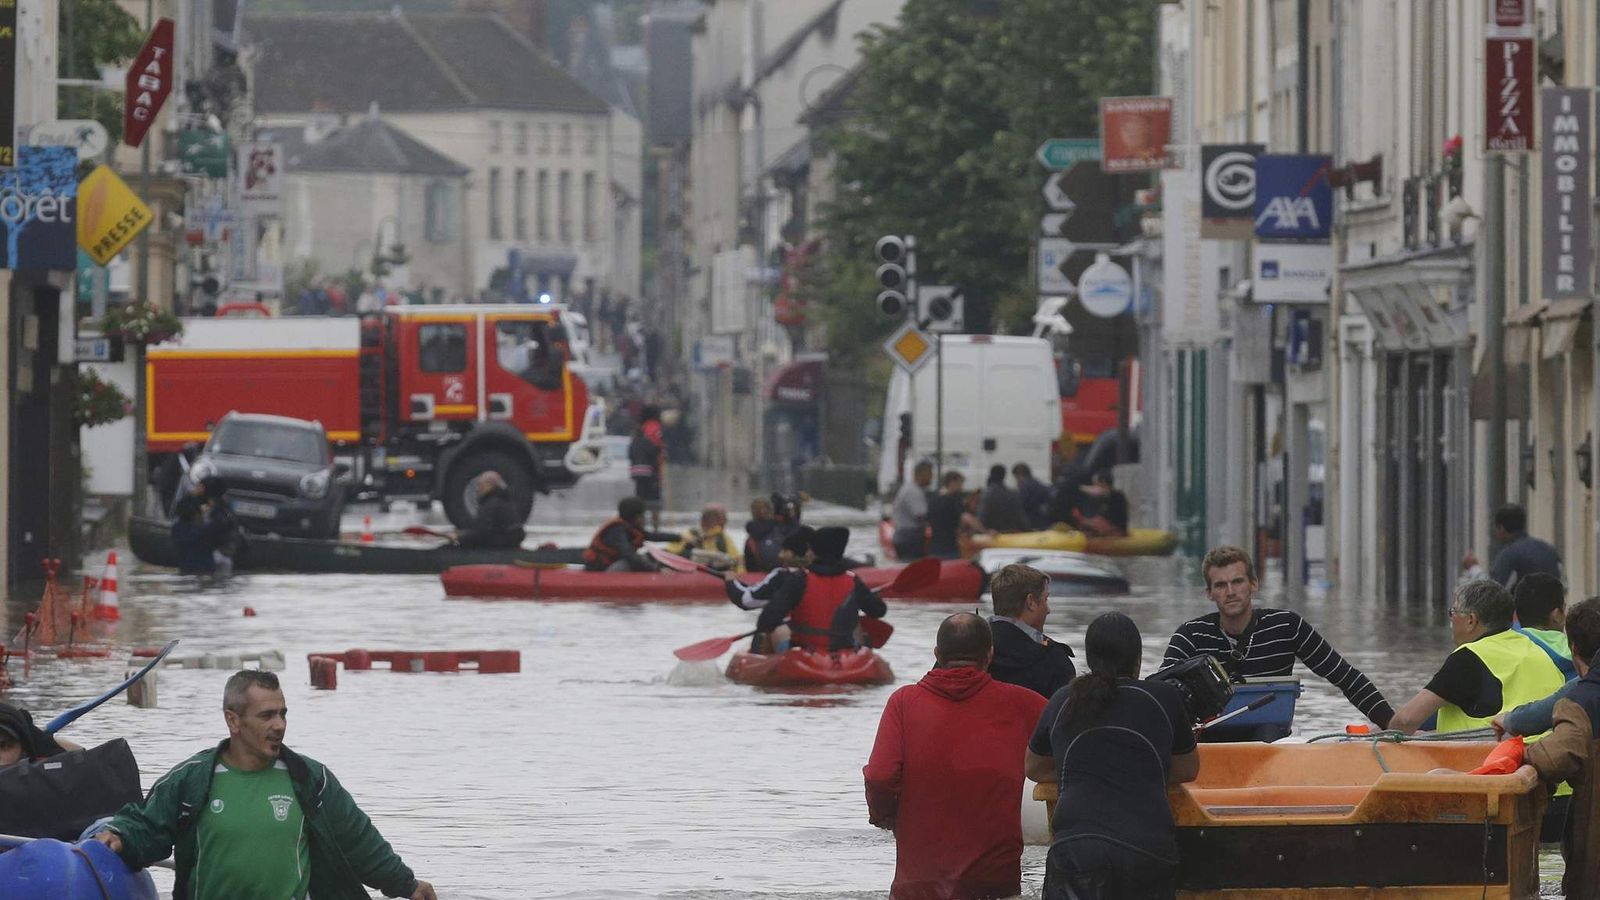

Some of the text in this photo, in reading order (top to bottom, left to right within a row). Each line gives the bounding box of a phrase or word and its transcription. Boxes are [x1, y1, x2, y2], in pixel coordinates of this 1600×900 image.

[133, 46, 166, 121] TABAC
[1500, 41, 1520, 134] PIZZA
[1254, 196, 1321, 230] AXA
[1553, 95, 1580, 292] IMMOBILIER
[92, 206, 144, 258] PRESSE
